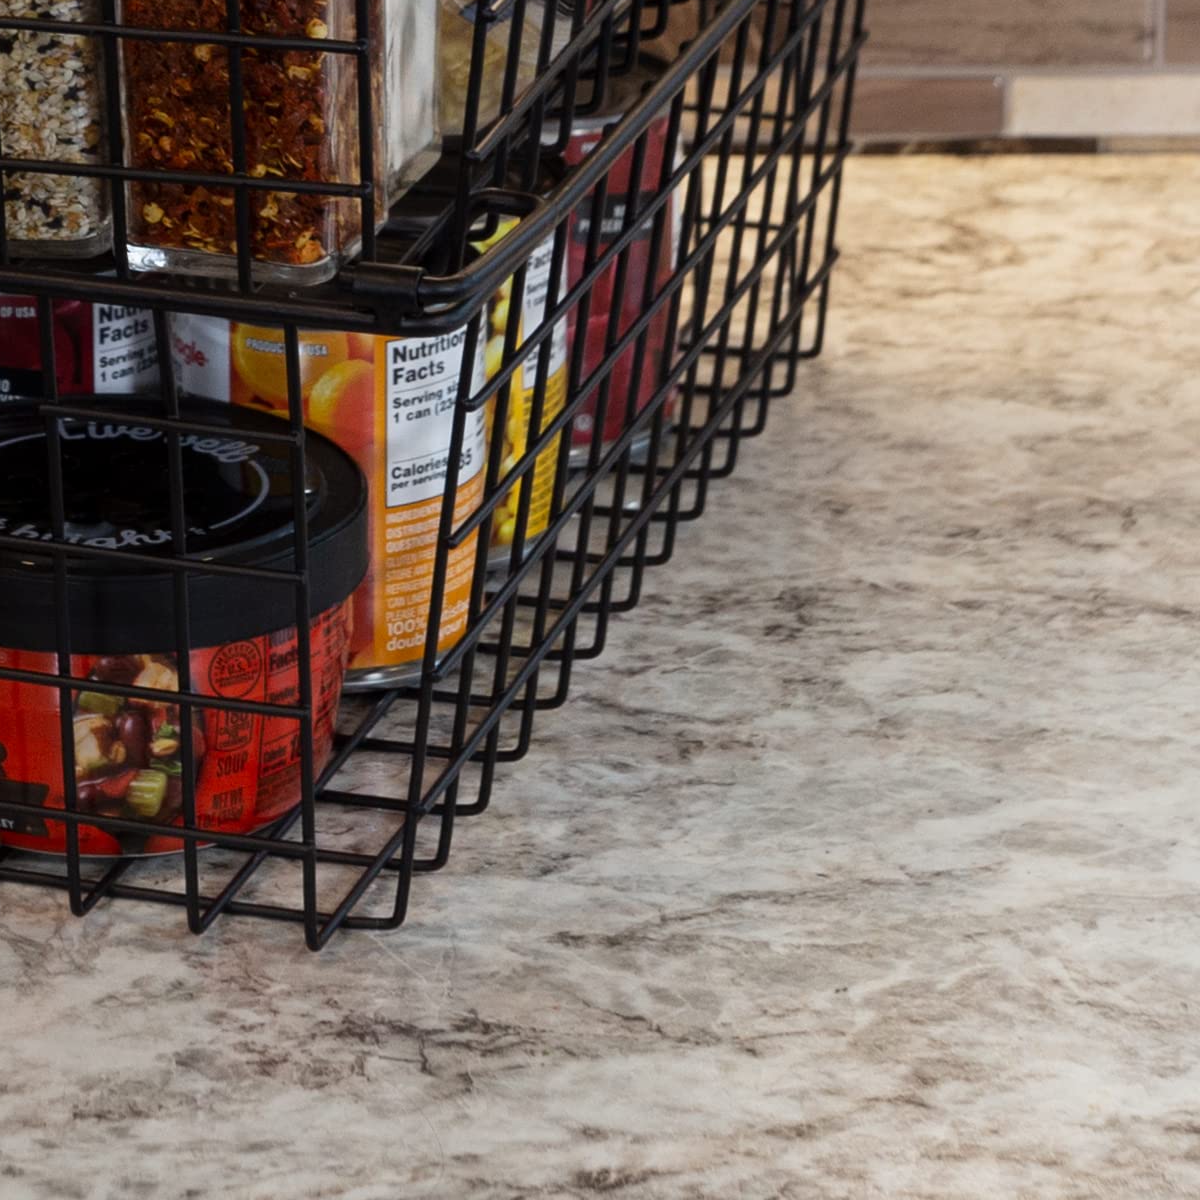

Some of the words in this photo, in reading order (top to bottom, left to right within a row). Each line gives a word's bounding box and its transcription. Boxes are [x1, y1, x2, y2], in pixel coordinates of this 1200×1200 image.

[0, 305, 14, 318] OF
[15, 306, 37, 318] USA
[99, 319, 149, 345] Facts
[392, 330, 467, 364] Nutrition
[111, 367, 135, 380] can
[392, 361, 445, 386] Facts
[392, 388, 443, 410] Serving
[393, 412, 400, 424] 1
[405, 406, 431, 422] can
[57, 416, 162, 441] Live
[391, 454, 449, 480] Calories
[391, 480, 409, 492] per
[216, 752, 248, 778] SOUP
